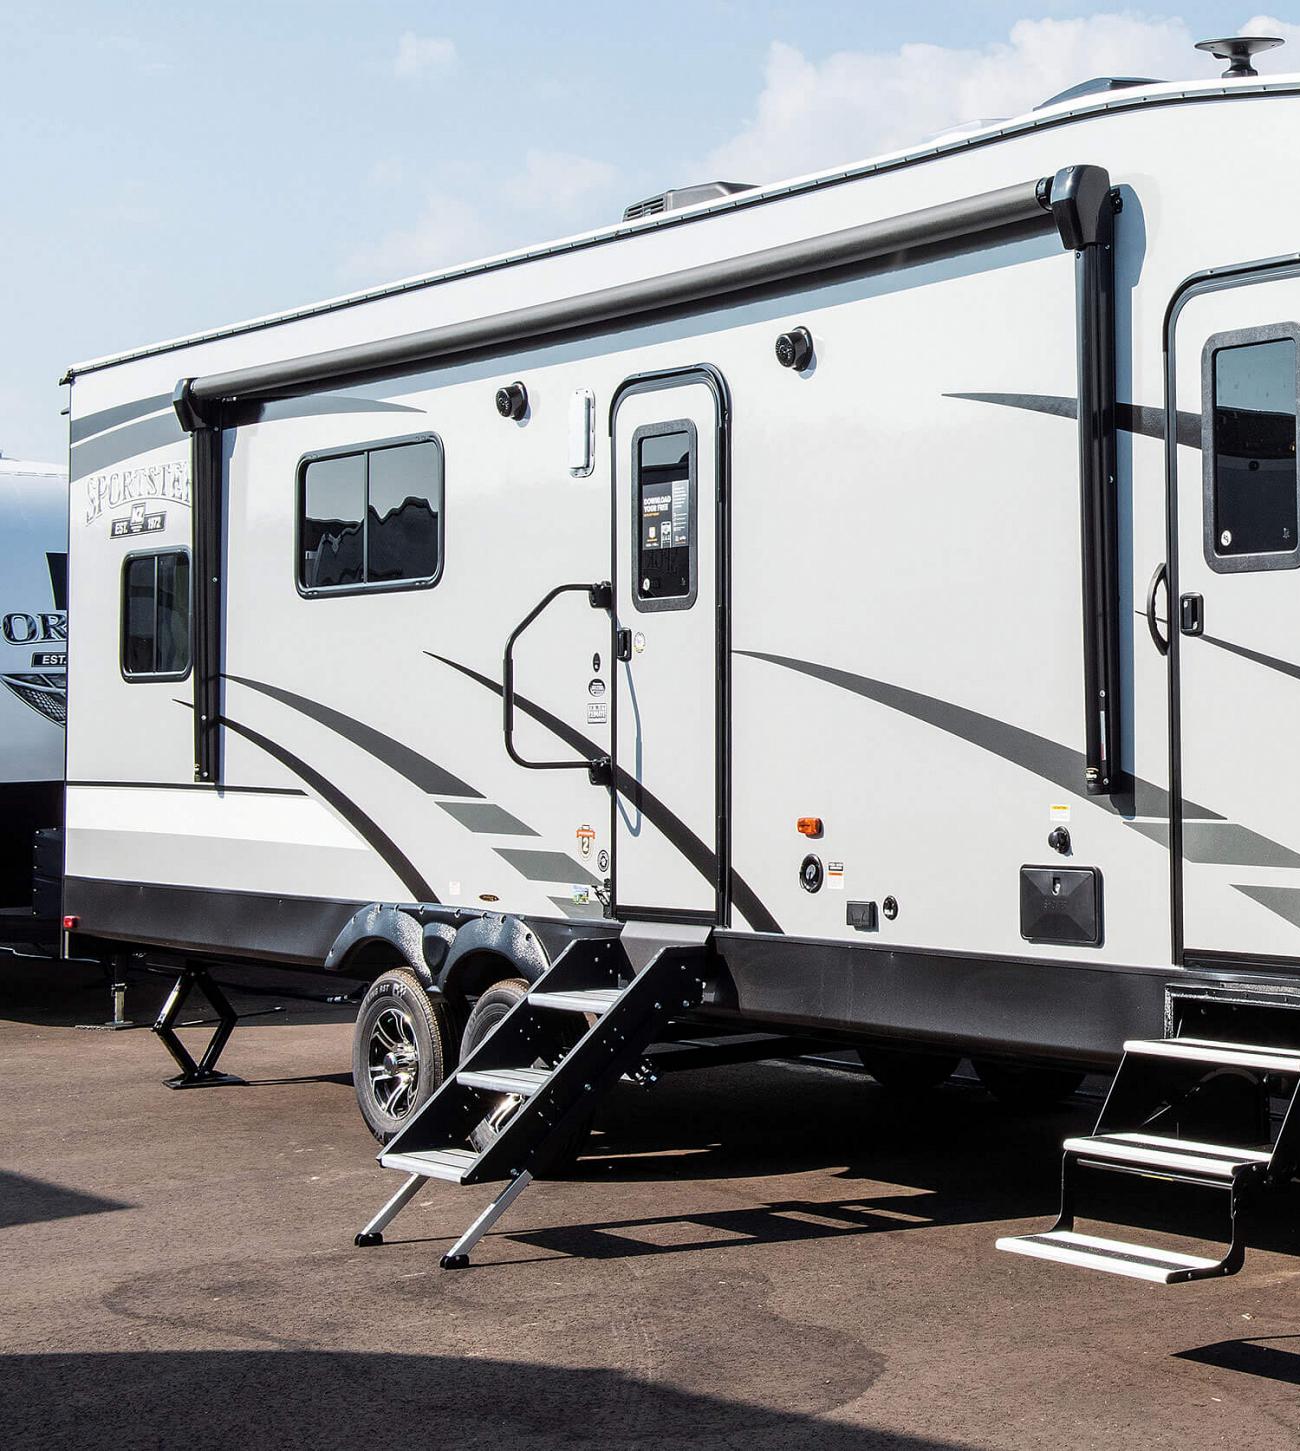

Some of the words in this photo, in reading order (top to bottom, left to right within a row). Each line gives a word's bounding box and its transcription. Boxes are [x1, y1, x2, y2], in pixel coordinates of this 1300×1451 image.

[643, 495, 672, 505] DOWNLOAD
[643, 505, 657, 513] YOUR
[657, 503, 669, 511] FREE
[42, 655, 67, 665] EST.
